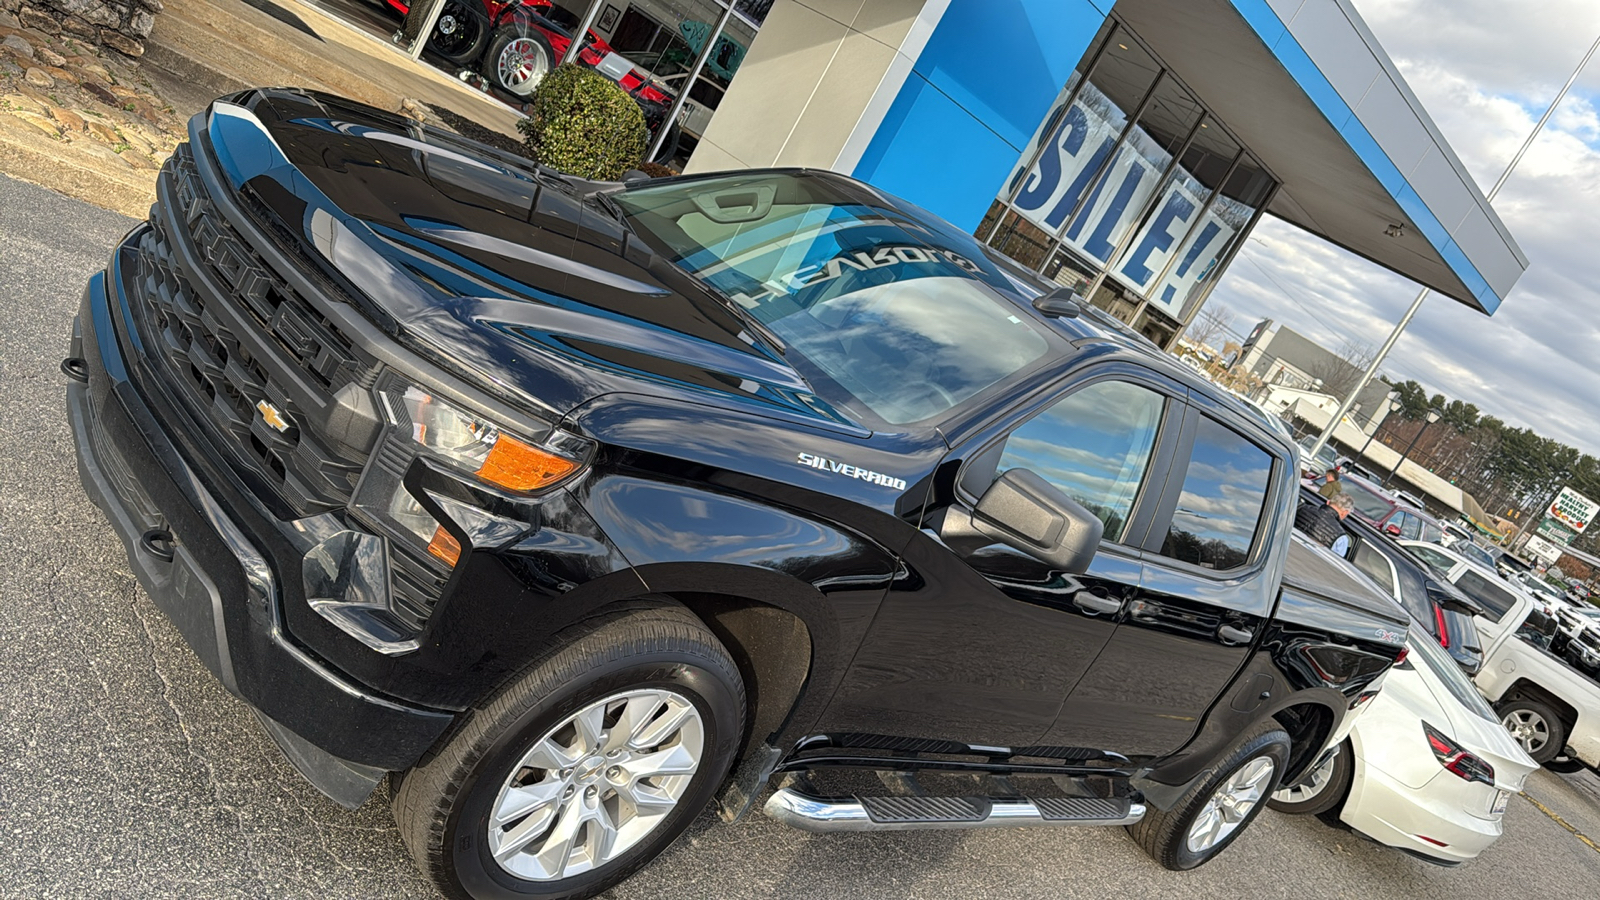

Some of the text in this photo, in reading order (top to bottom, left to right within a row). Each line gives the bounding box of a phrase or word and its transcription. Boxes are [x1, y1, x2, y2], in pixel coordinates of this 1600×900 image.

[1009, 103, 1222, 306] SALE!
[167, 143, 359, 384] HEVROLET
[797, 452, 907, 491] SILVERADO
[1557, 505, 1589, 526] PRODUCE
[1559, 499, 1589, 519] HARVEST
[1560, 492, 1589, 511] HEALTHY
